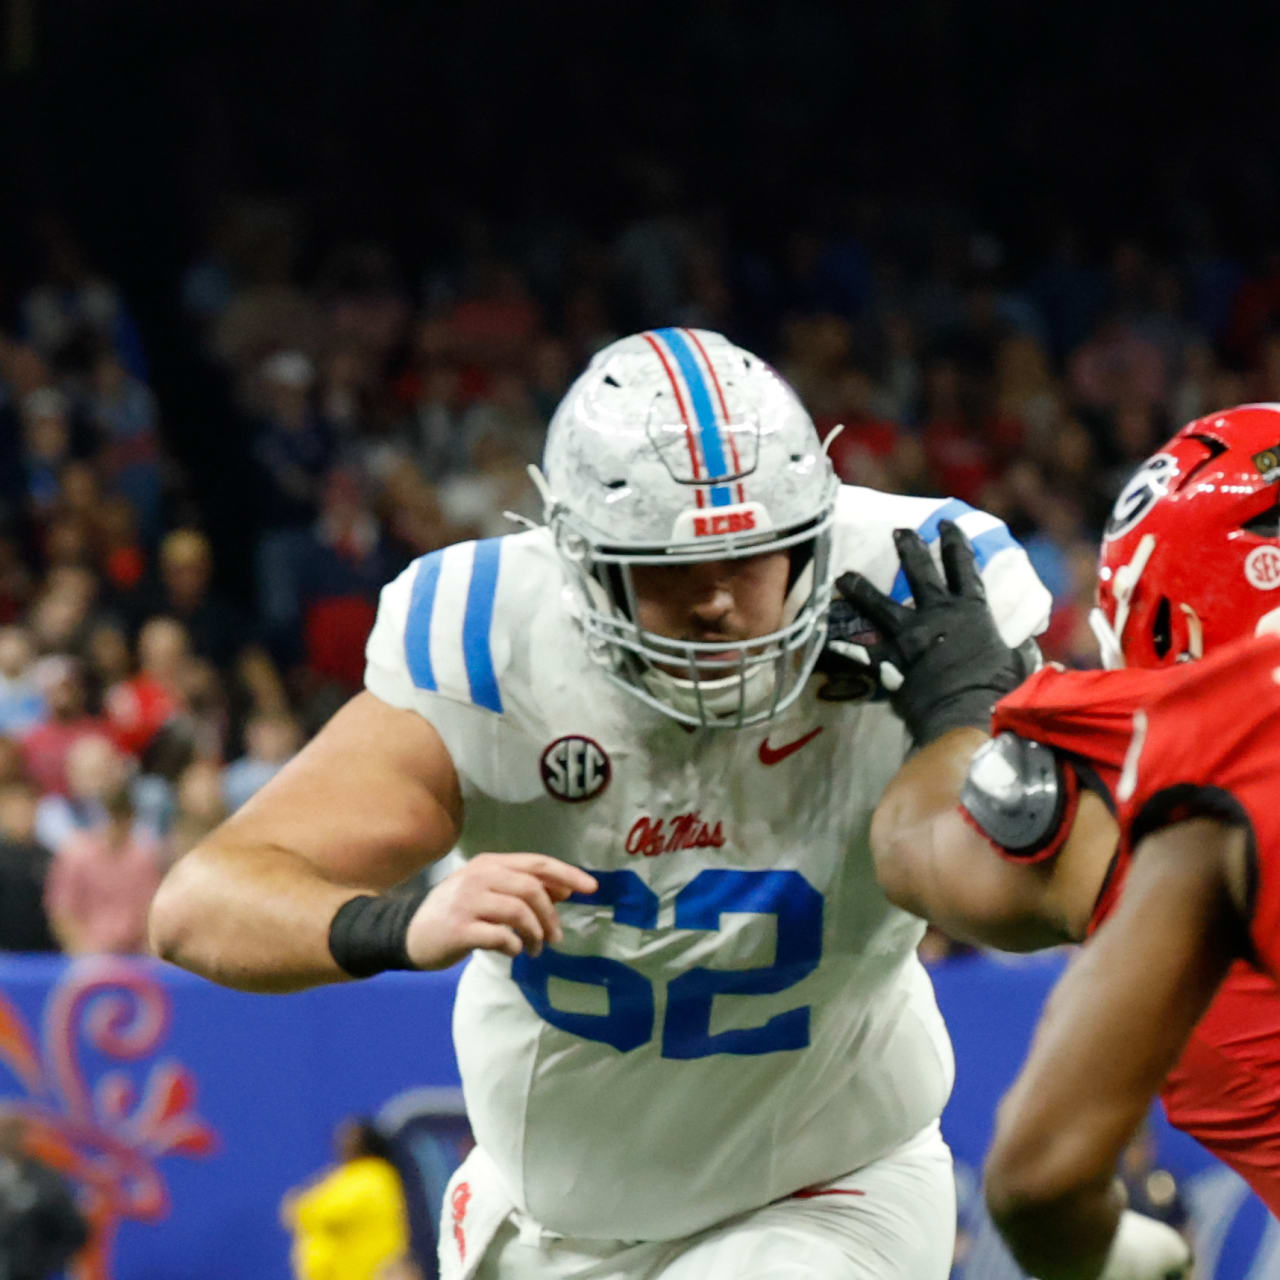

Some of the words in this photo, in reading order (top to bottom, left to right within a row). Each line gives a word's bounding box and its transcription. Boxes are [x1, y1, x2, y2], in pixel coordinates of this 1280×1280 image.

[693, 510, 756, 537] REBS
[543, 739, 605, 799] SEC
[625, 816, 667, 857] Ole
[663, 810, 727, 852] Miss
[510, 868, 825, 1061] 62
